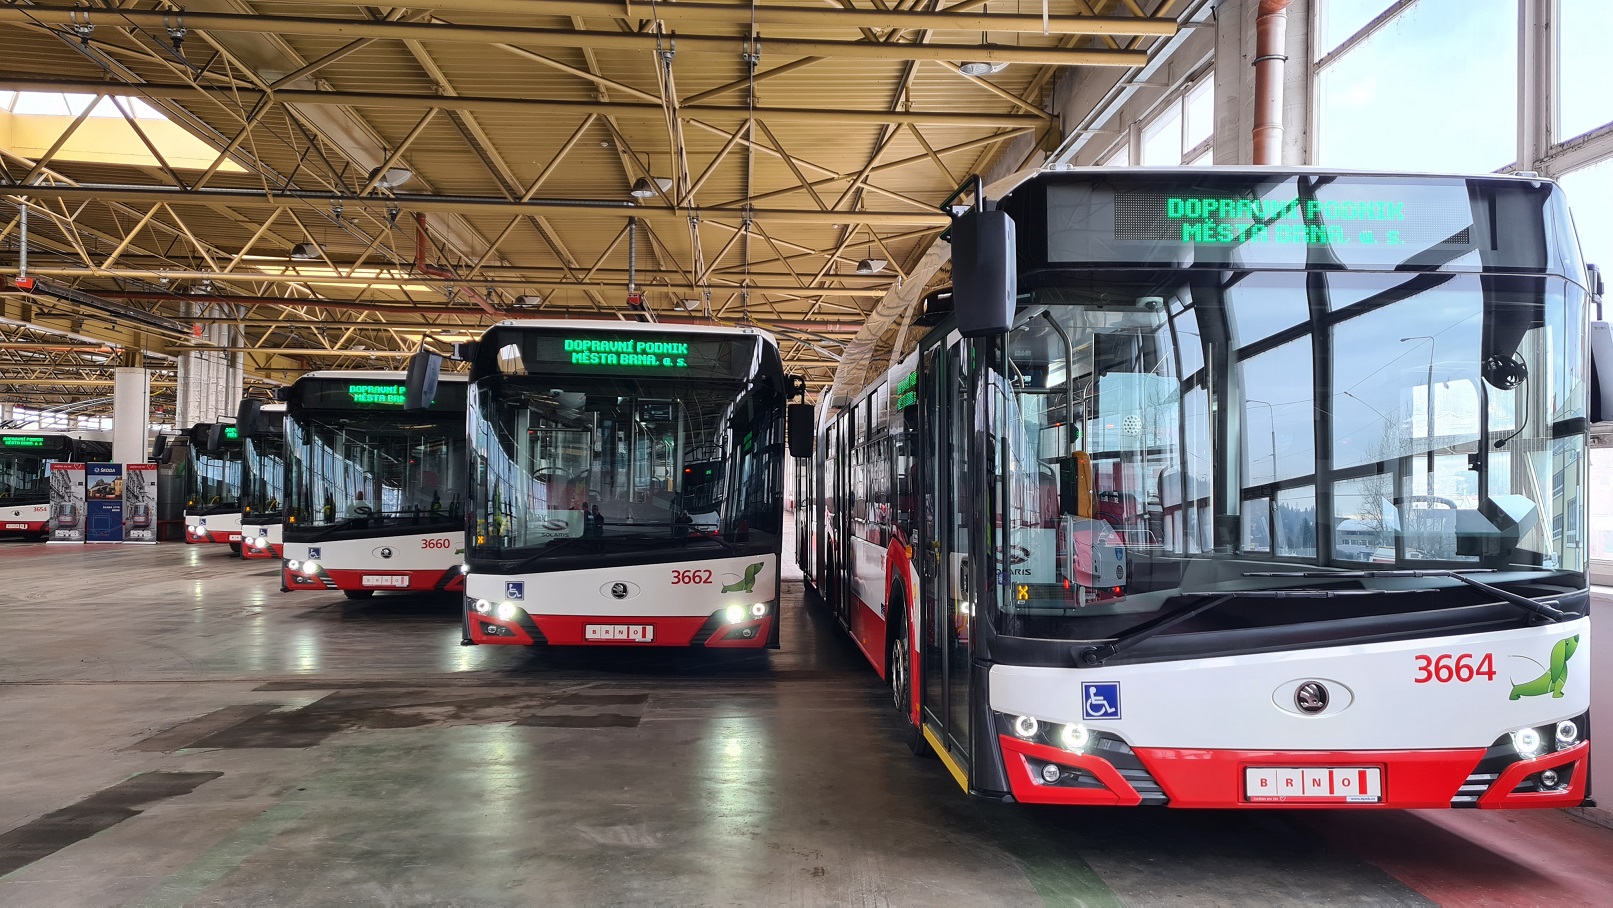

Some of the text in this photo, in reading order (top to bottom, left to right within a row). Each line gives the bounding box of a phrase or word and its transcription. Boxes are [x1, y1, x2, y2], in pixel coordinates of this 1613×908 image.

[1167, 197, 1405, 221] DOPRAVNÍ PODNIK
[1182, 219, 1268, 242] MĚSTA
[564, 339, 688, 354] DOPRAVNÍ PODNIK
[571, 350, 617, 364] MĚSTA
[676, 358, 688, 367] s.
[349, 384, 398, 394] DOPRAVNÍ
[353, 393, 386, 402] MĚSTA
[421, 538, 451, 549] 3660
[671, 569, 713, 585] 3662
[1414, 652, 1497, 684] 3664
